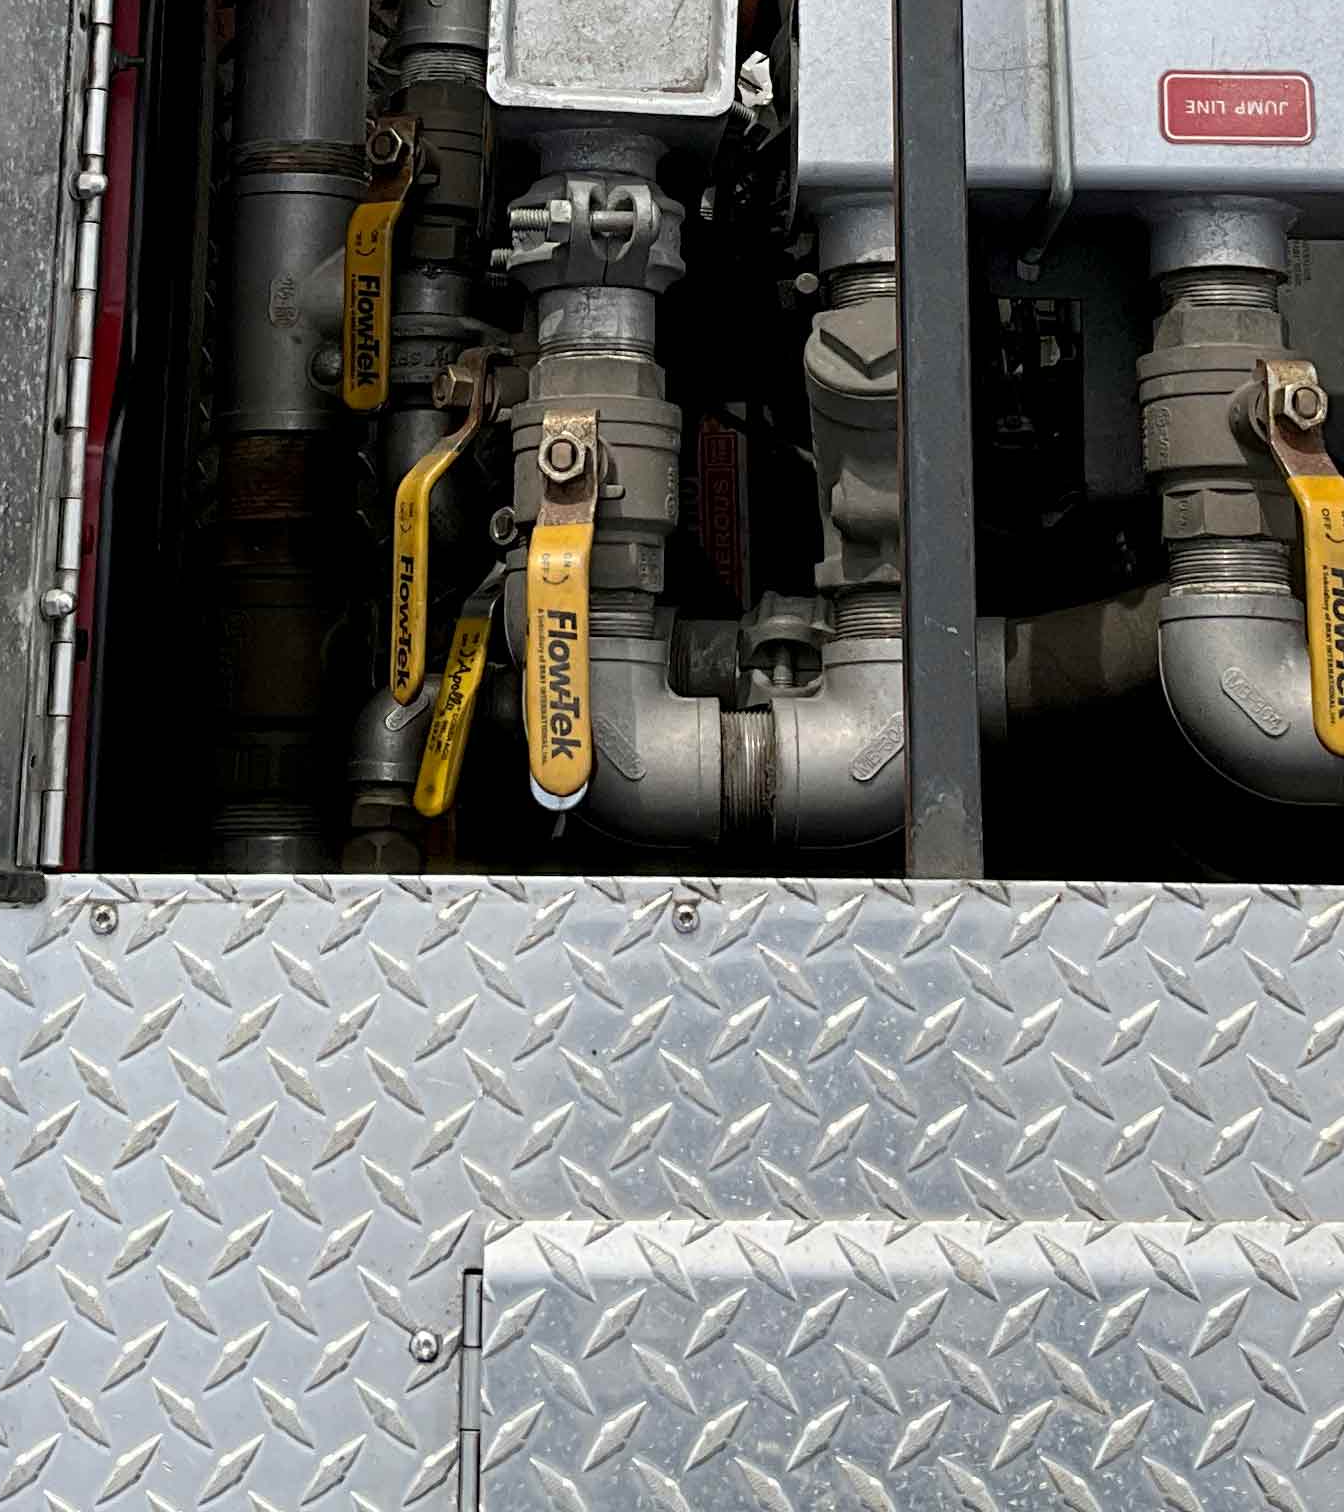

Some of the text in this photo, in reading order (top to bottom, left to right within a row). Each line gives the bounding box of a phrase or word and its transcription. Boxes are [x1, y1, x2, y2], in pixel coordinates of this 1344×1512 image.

[1184, 99, 1289, 117] JUMP LINE
[1320, 508, 1331, 531] OFF
